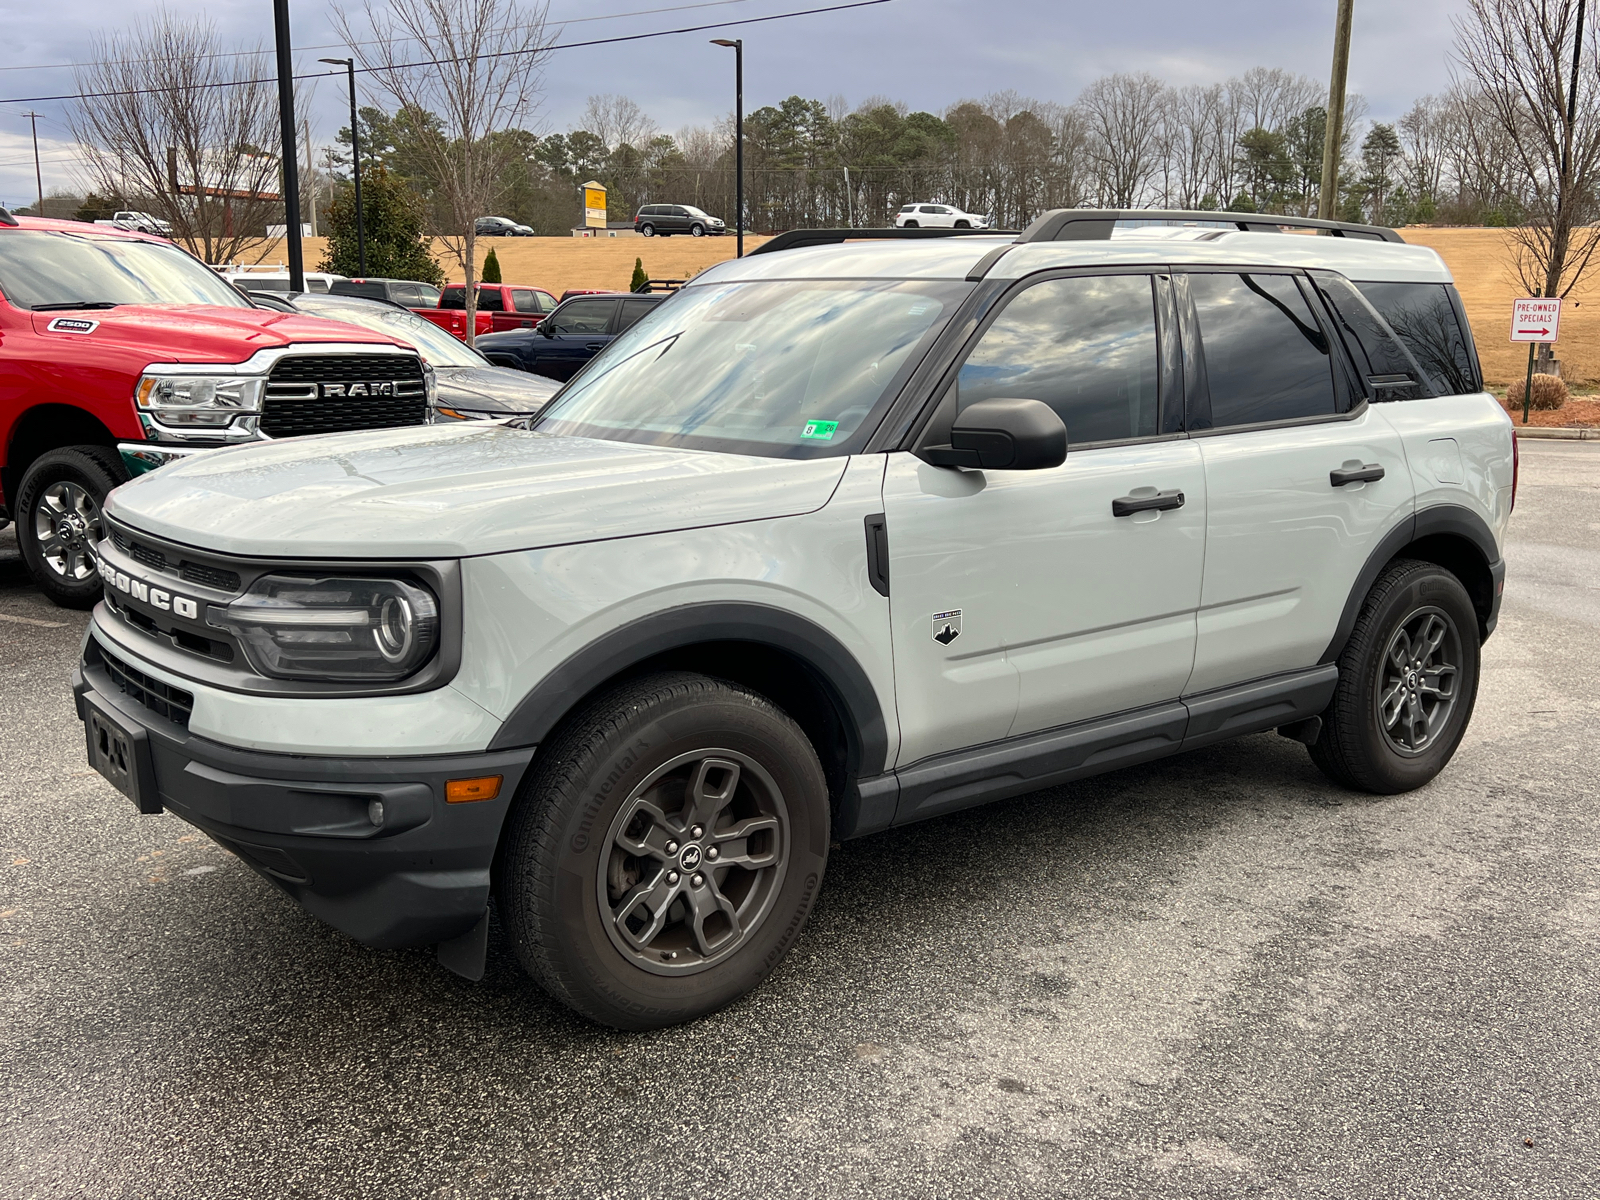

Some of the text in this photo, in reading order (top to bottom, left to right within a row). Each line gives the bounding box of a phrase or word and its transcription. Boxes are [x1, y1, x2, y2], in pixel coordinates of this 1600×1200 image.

[1517, 304, 1556, 312] PRE-OWNED
[1519, 314, 1552, 322] SPECIALS
[58, 320, 90, 328] 2500
[323, 383, 391, 397] RAM
[807, 426, 813, 434] 8
[97, 557, 198, 619] BRONCO
[569, 746, 640, 855] Continental
[761, 871, 818, 969] Continental
